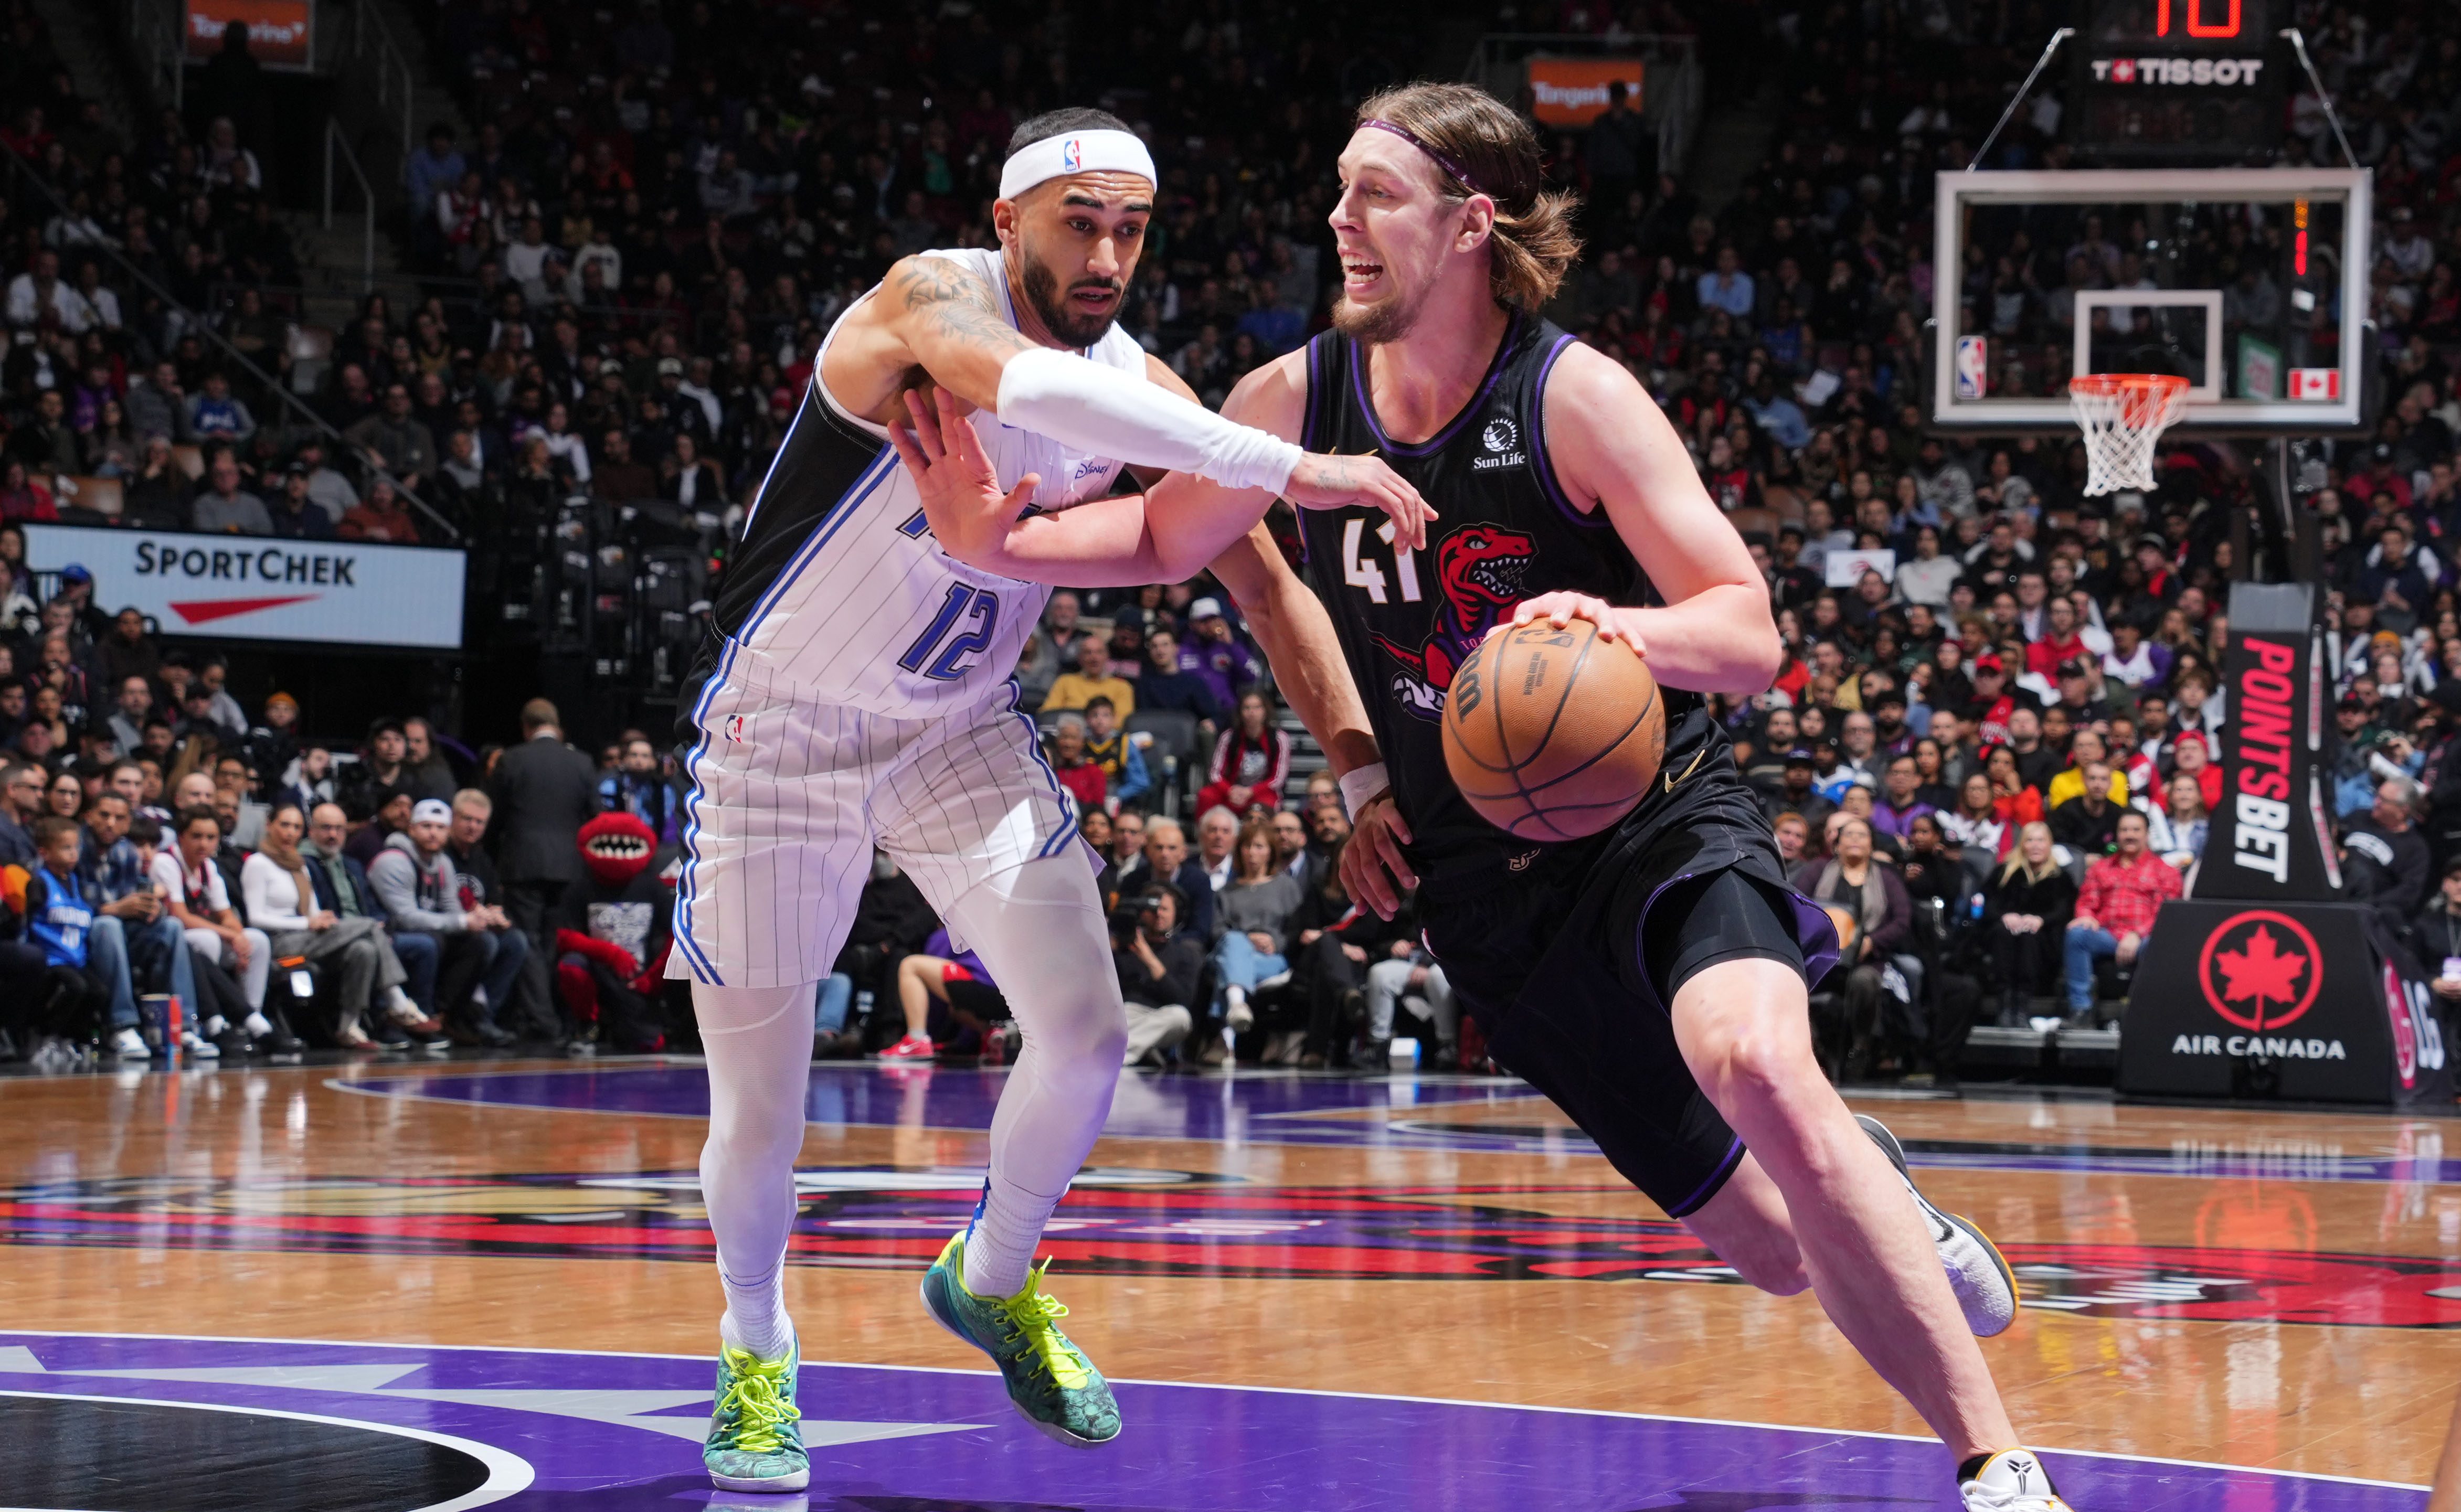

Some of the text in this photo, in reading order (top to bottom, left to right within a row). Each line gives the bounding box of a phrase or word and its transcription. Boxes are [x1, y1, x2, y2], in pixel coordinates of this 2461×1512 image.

[2137, 58, 2263, 86] TISSOT
[1473, 452, 1525, 469] Sun Life
[897, 581, 999, 681] 12
[2234, 637, 2295, 883] POINTSBET
[2172, 1034, 2346, 1060] AIR CANADA
